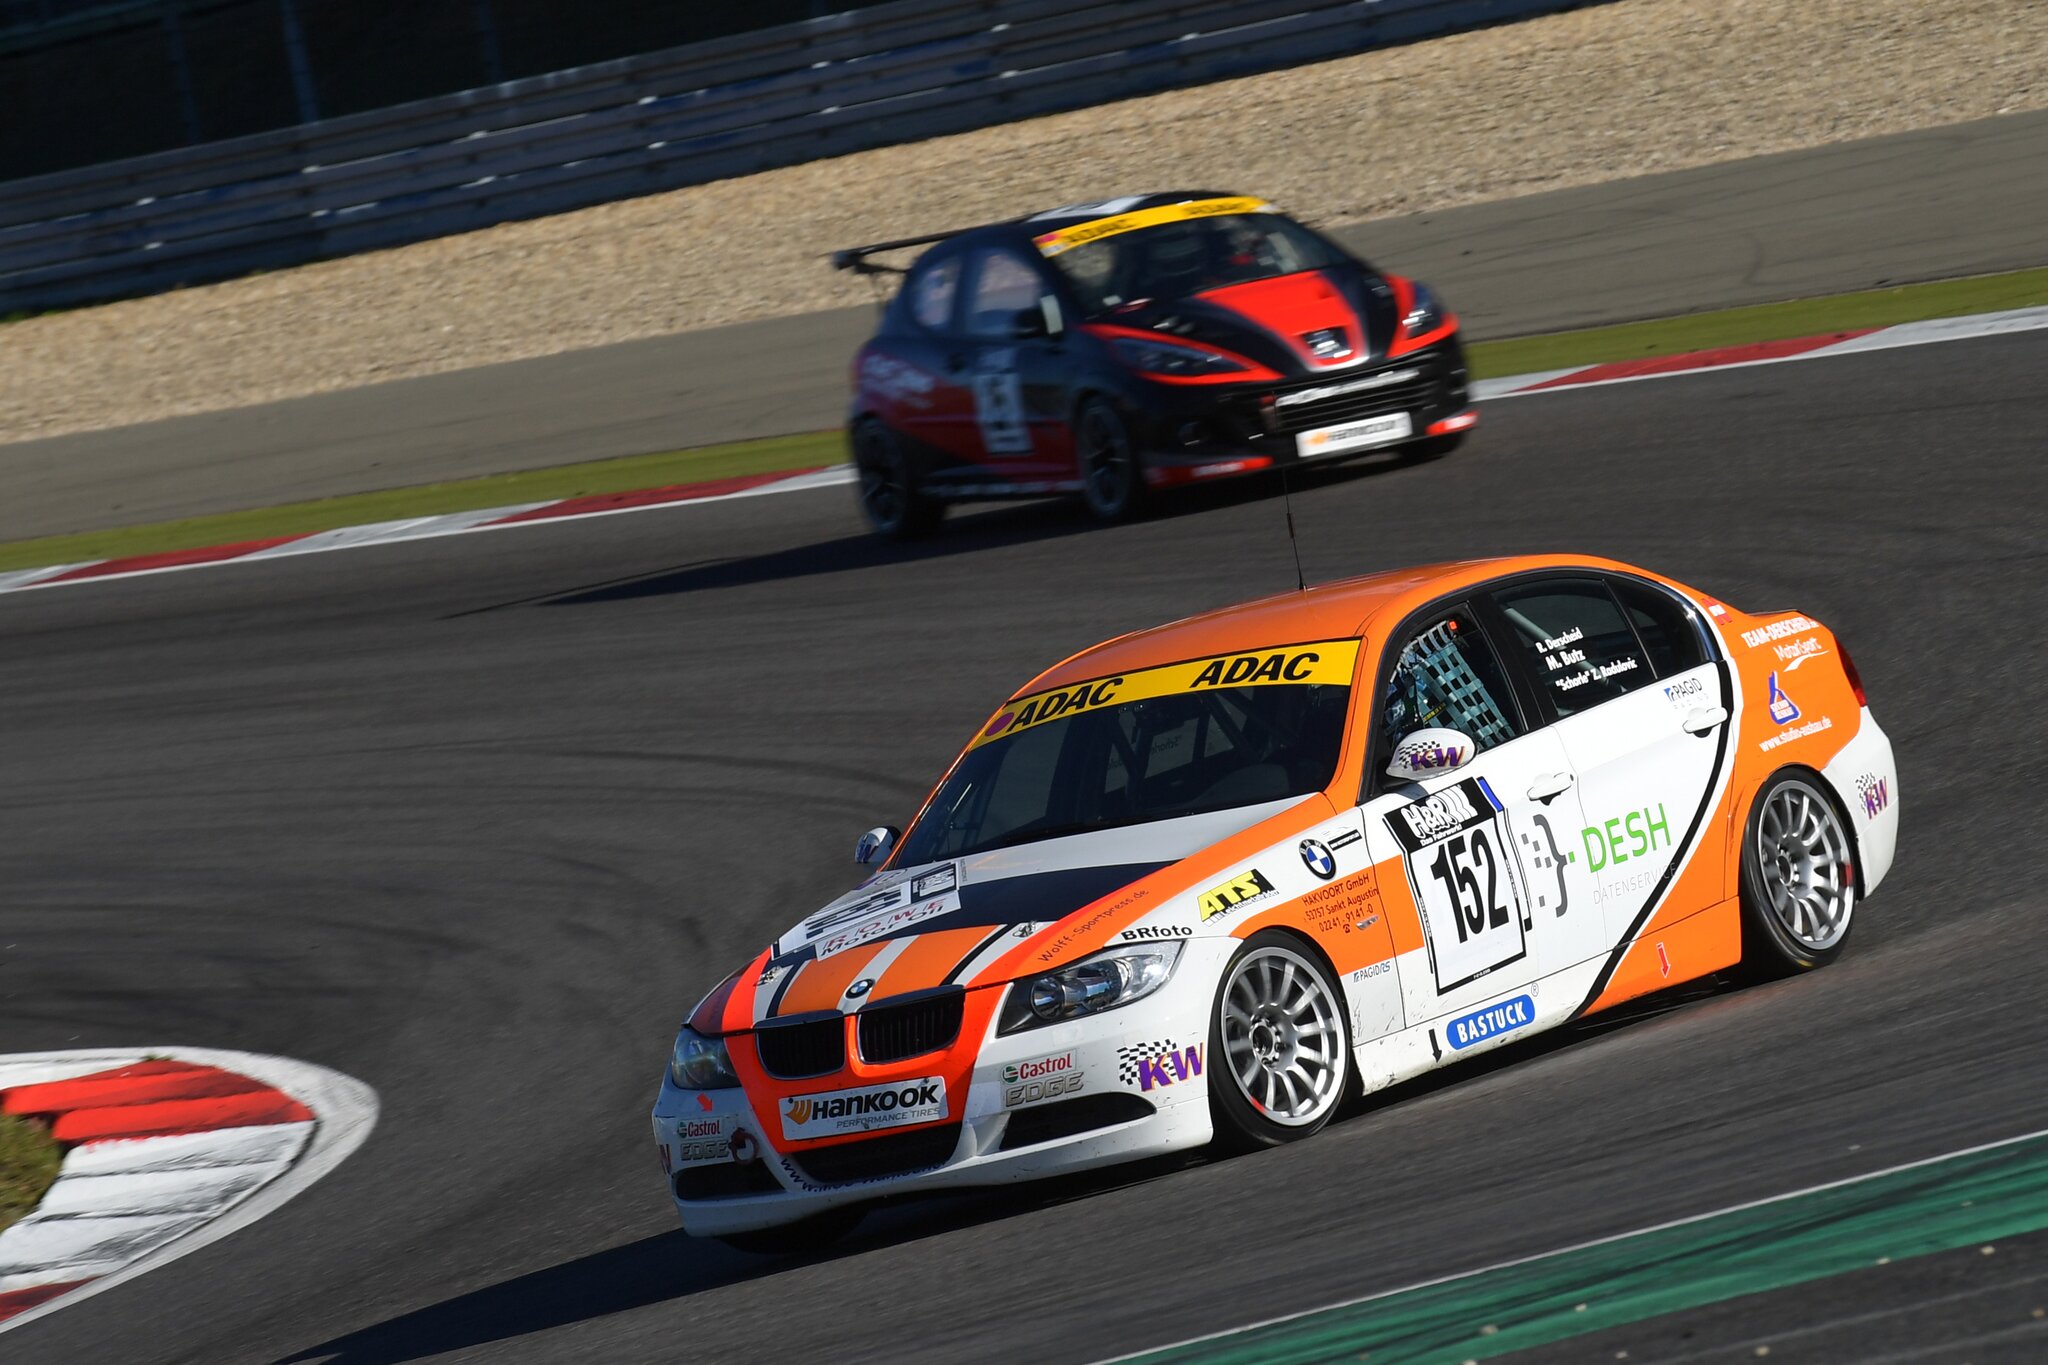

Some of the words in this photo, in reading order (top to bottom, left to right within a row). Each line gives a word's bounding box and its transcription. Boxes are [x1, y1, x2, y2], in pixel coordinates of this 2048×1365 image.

[1545, 627, 1583, 649] Derscheid
[1190, 652, 1320, 688] ADAC
[1546, 656, 1562, 671] M.
[1560, 649, 1586, 667] Butz
[1599, 658, 1638, 677] Radulovic
[1006, 677, 1124, 732] ADAC
[1672, 678, 1703, 699] PAGID
[1411, 745, 1466, 772] KW
[1864, 776, 1888, 820] KW
[1581, 803, 1672, 873] DESH
[1197, 870, 1261, 922] ATS
[1302, 884, 1345, 906] HAKVOORT
[1346, 873, 1370, 892] GmbH
[1430, 828, 1510, 944] 152
[1306, 907, 1325, 921] 53757
[1326, 900, 1347, 916] Sankt
[1347, 887, 1380, 906] Augustin
[821, 922, 893, 955] Motor
[907, 906, 943, 922] Oil
[1037, 889, 1150, 963] Wolff-Sportpress.de
[1121, 924, 1193, 941] BRfoto
[1456, 1001, 1527, 1044] BASTUCK
[1019, 1053, 1072, 1080] Castrol
[1137, 1042, 1204, 1092] KW
[811, 1084, 940, 1120] HANKOOK
[1005, 1071, 1085, 1108] EDGE
[687, 1119, 721, 1137] Castrol
[836, 1110, 908, 1128] PERFORMANCE
[911, 1107, 941, 1119] TIRES
[680, 1139, 730, 1162] EDGE
